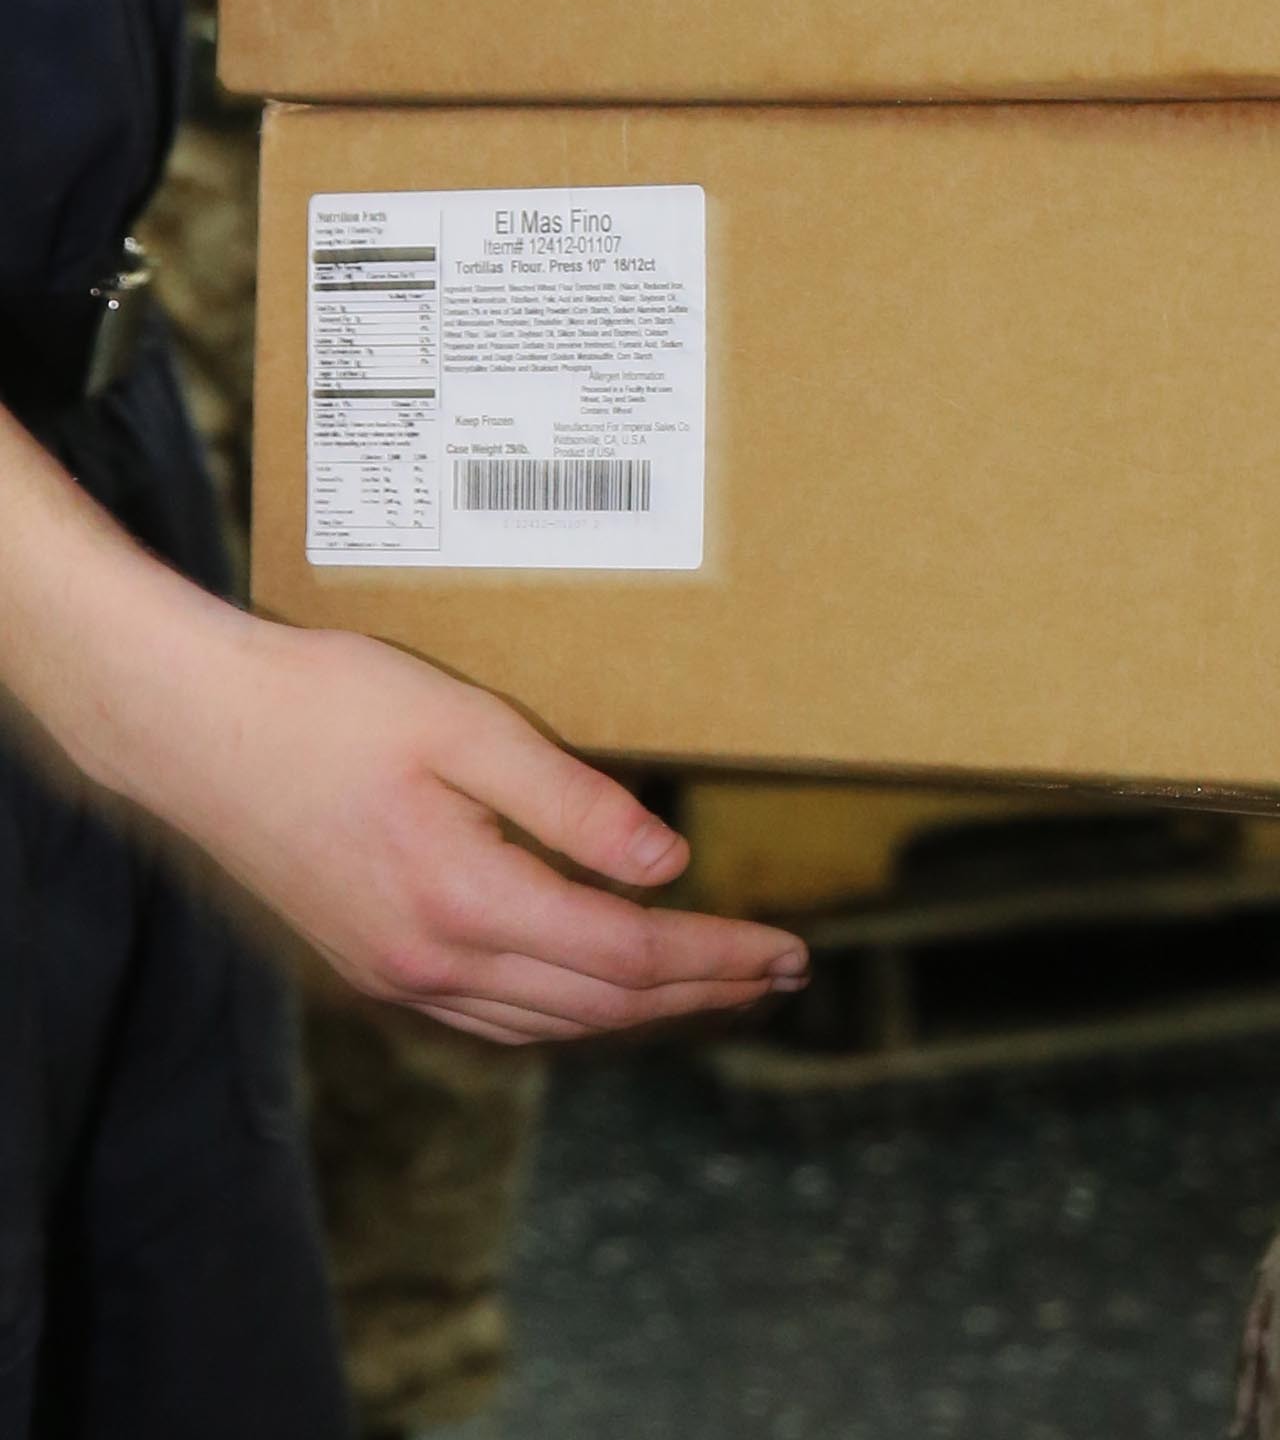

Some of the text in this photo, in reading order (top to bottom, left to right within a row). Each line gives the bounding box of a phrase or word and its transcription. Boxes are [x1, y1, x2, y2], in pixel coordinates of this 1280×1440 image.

[495, 207, 613, 235] El Mas Fino
[483, 235, 622, 256] Item# 12412-01107
[455, 260, 504, 274] Tortillas
[549, 259, 584, 273] Press
[612, 258, 656, 273] 18/12ct
[482, 414, 514, 426] Frozen
